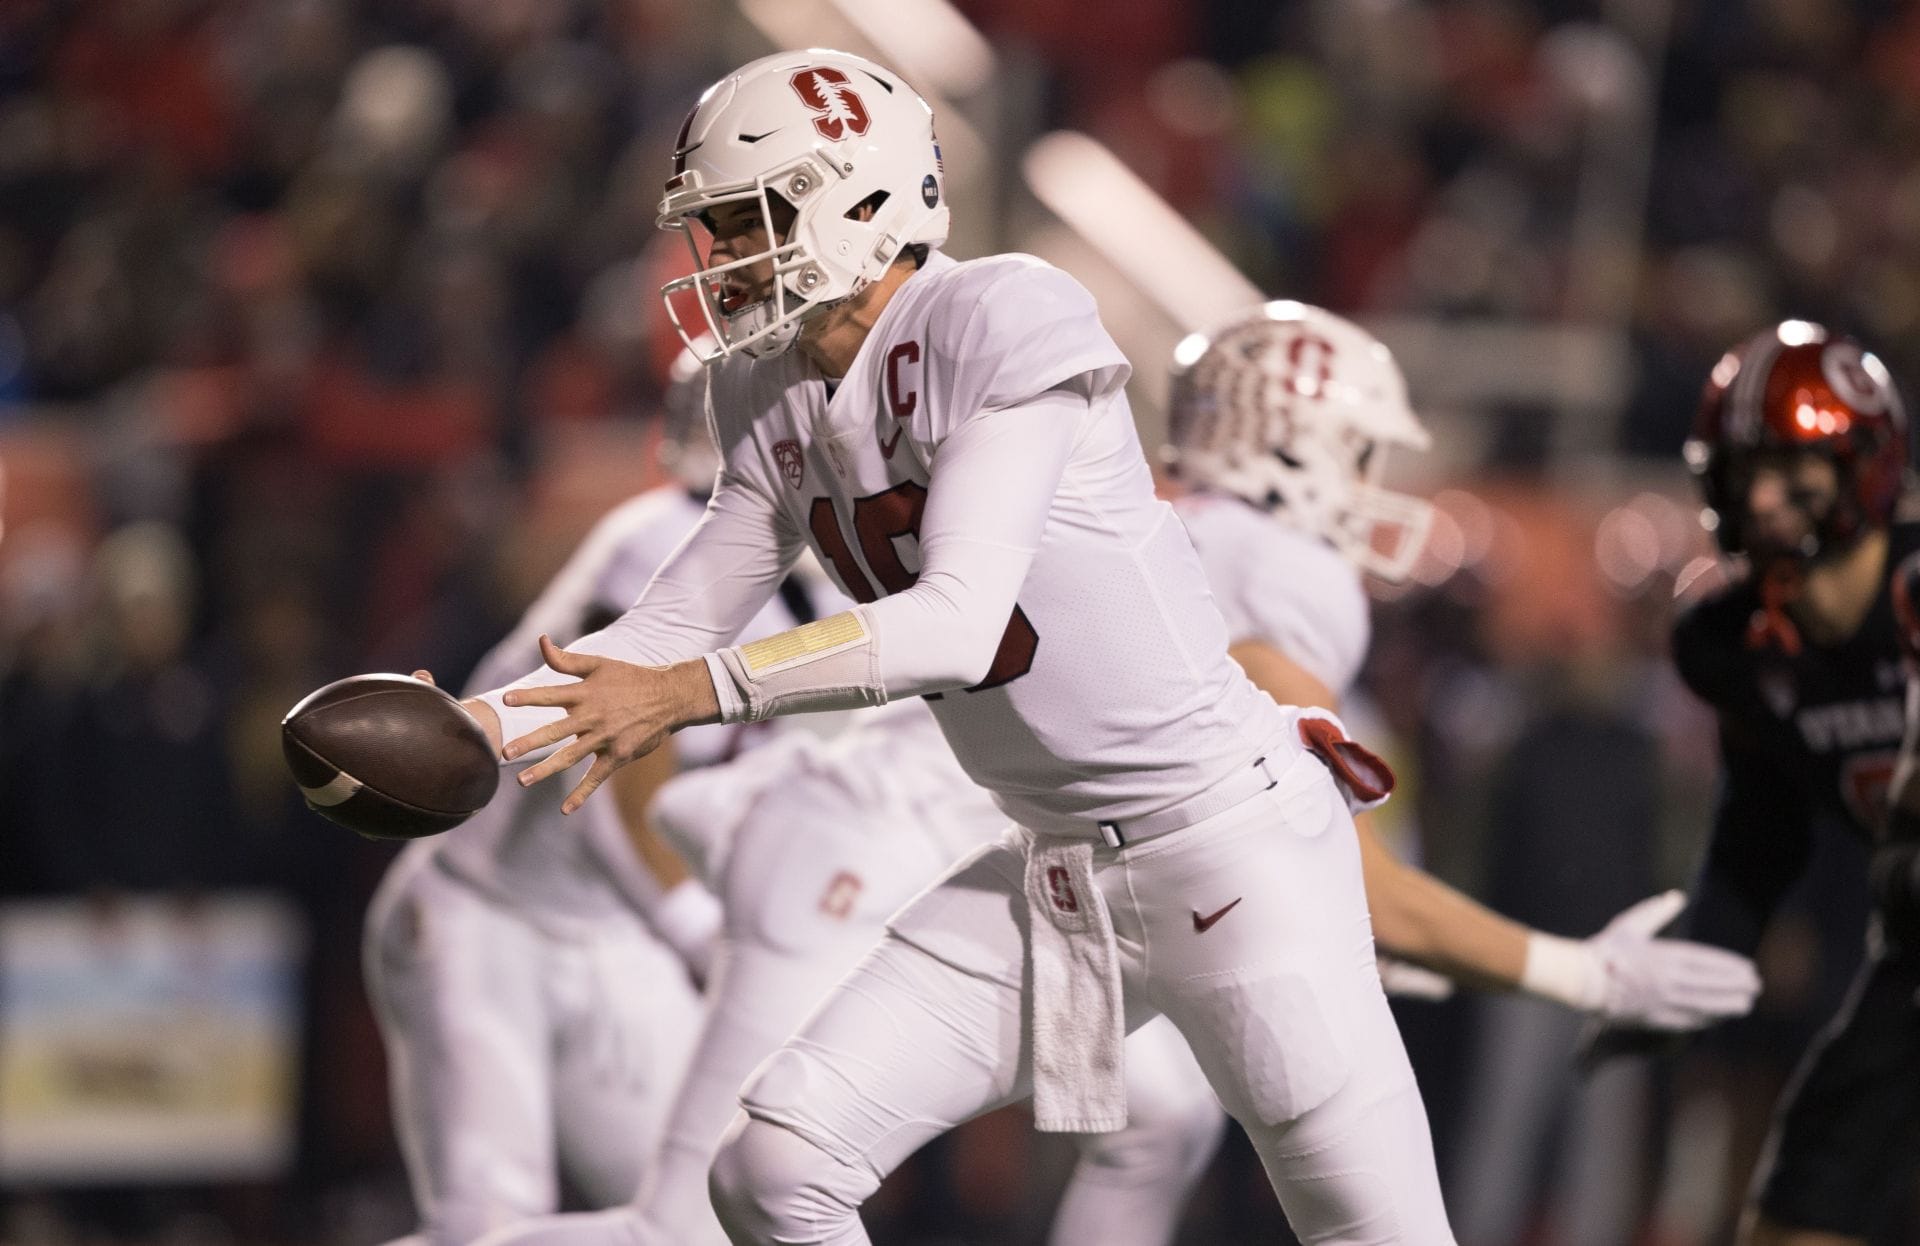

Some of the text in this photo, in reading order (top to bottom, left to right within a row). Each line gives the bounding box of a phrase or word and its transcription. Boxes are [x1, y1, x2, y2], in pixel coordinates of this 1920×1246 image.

[789, 66, 872, 142] S
[887, 340, 919, 417] C
[1047, 865, 1078, 912] S
